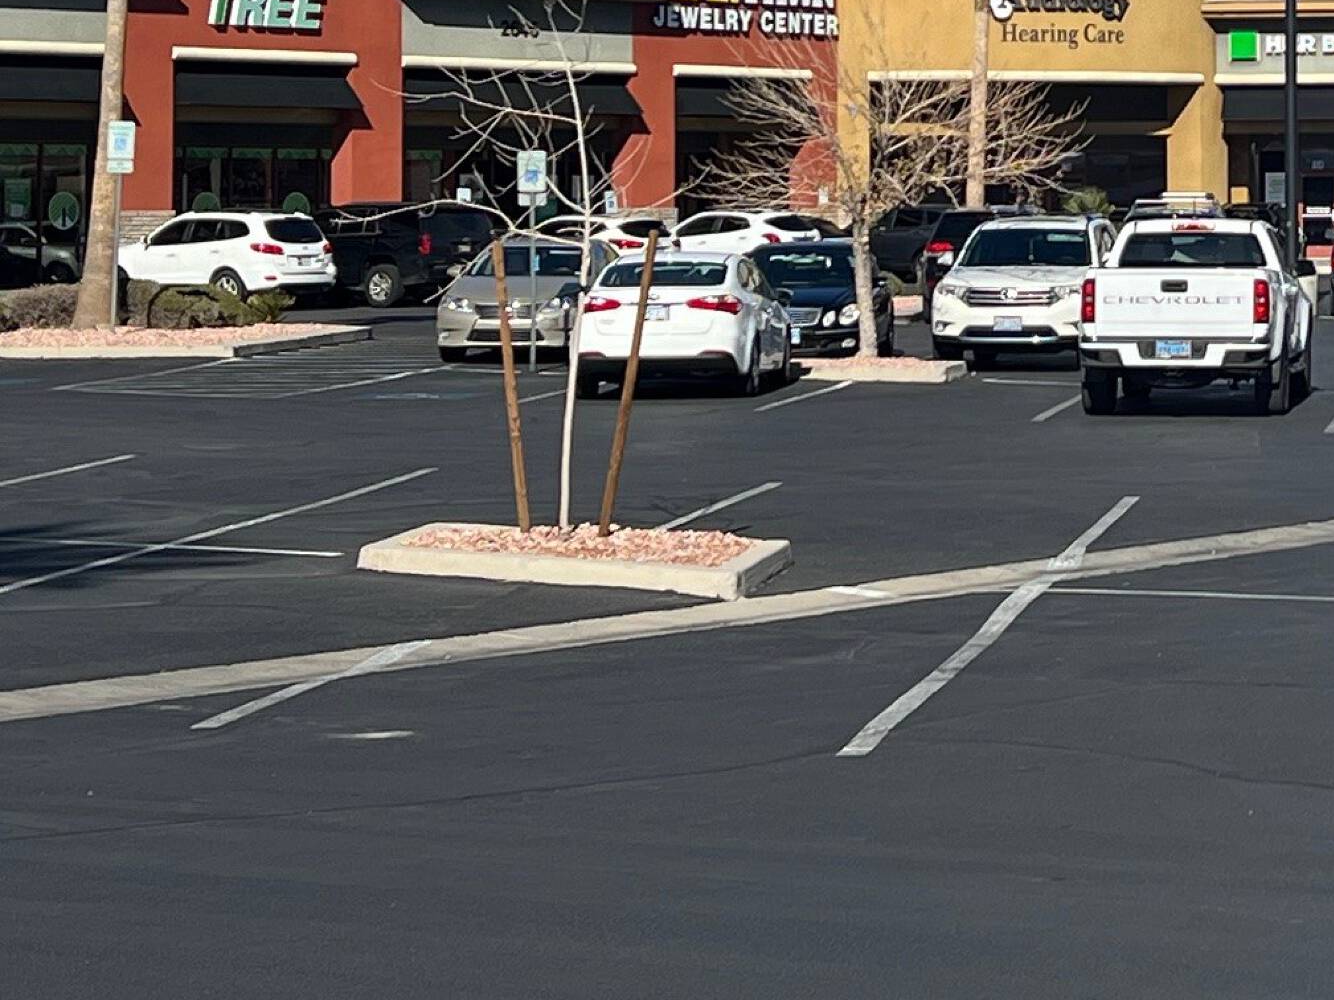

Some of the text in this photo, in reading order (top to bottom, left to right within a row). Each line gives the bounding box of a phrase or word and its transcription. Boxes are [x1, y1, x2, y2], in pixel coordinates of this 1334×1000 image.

[653, 4, 839, 36] JEWELRY CENTER
[1001, 23, 1125, 50] Hearing Care
[1265, 34, 1317, 54] HR
[1103, 295, 1244, 305] CHEVROLET
